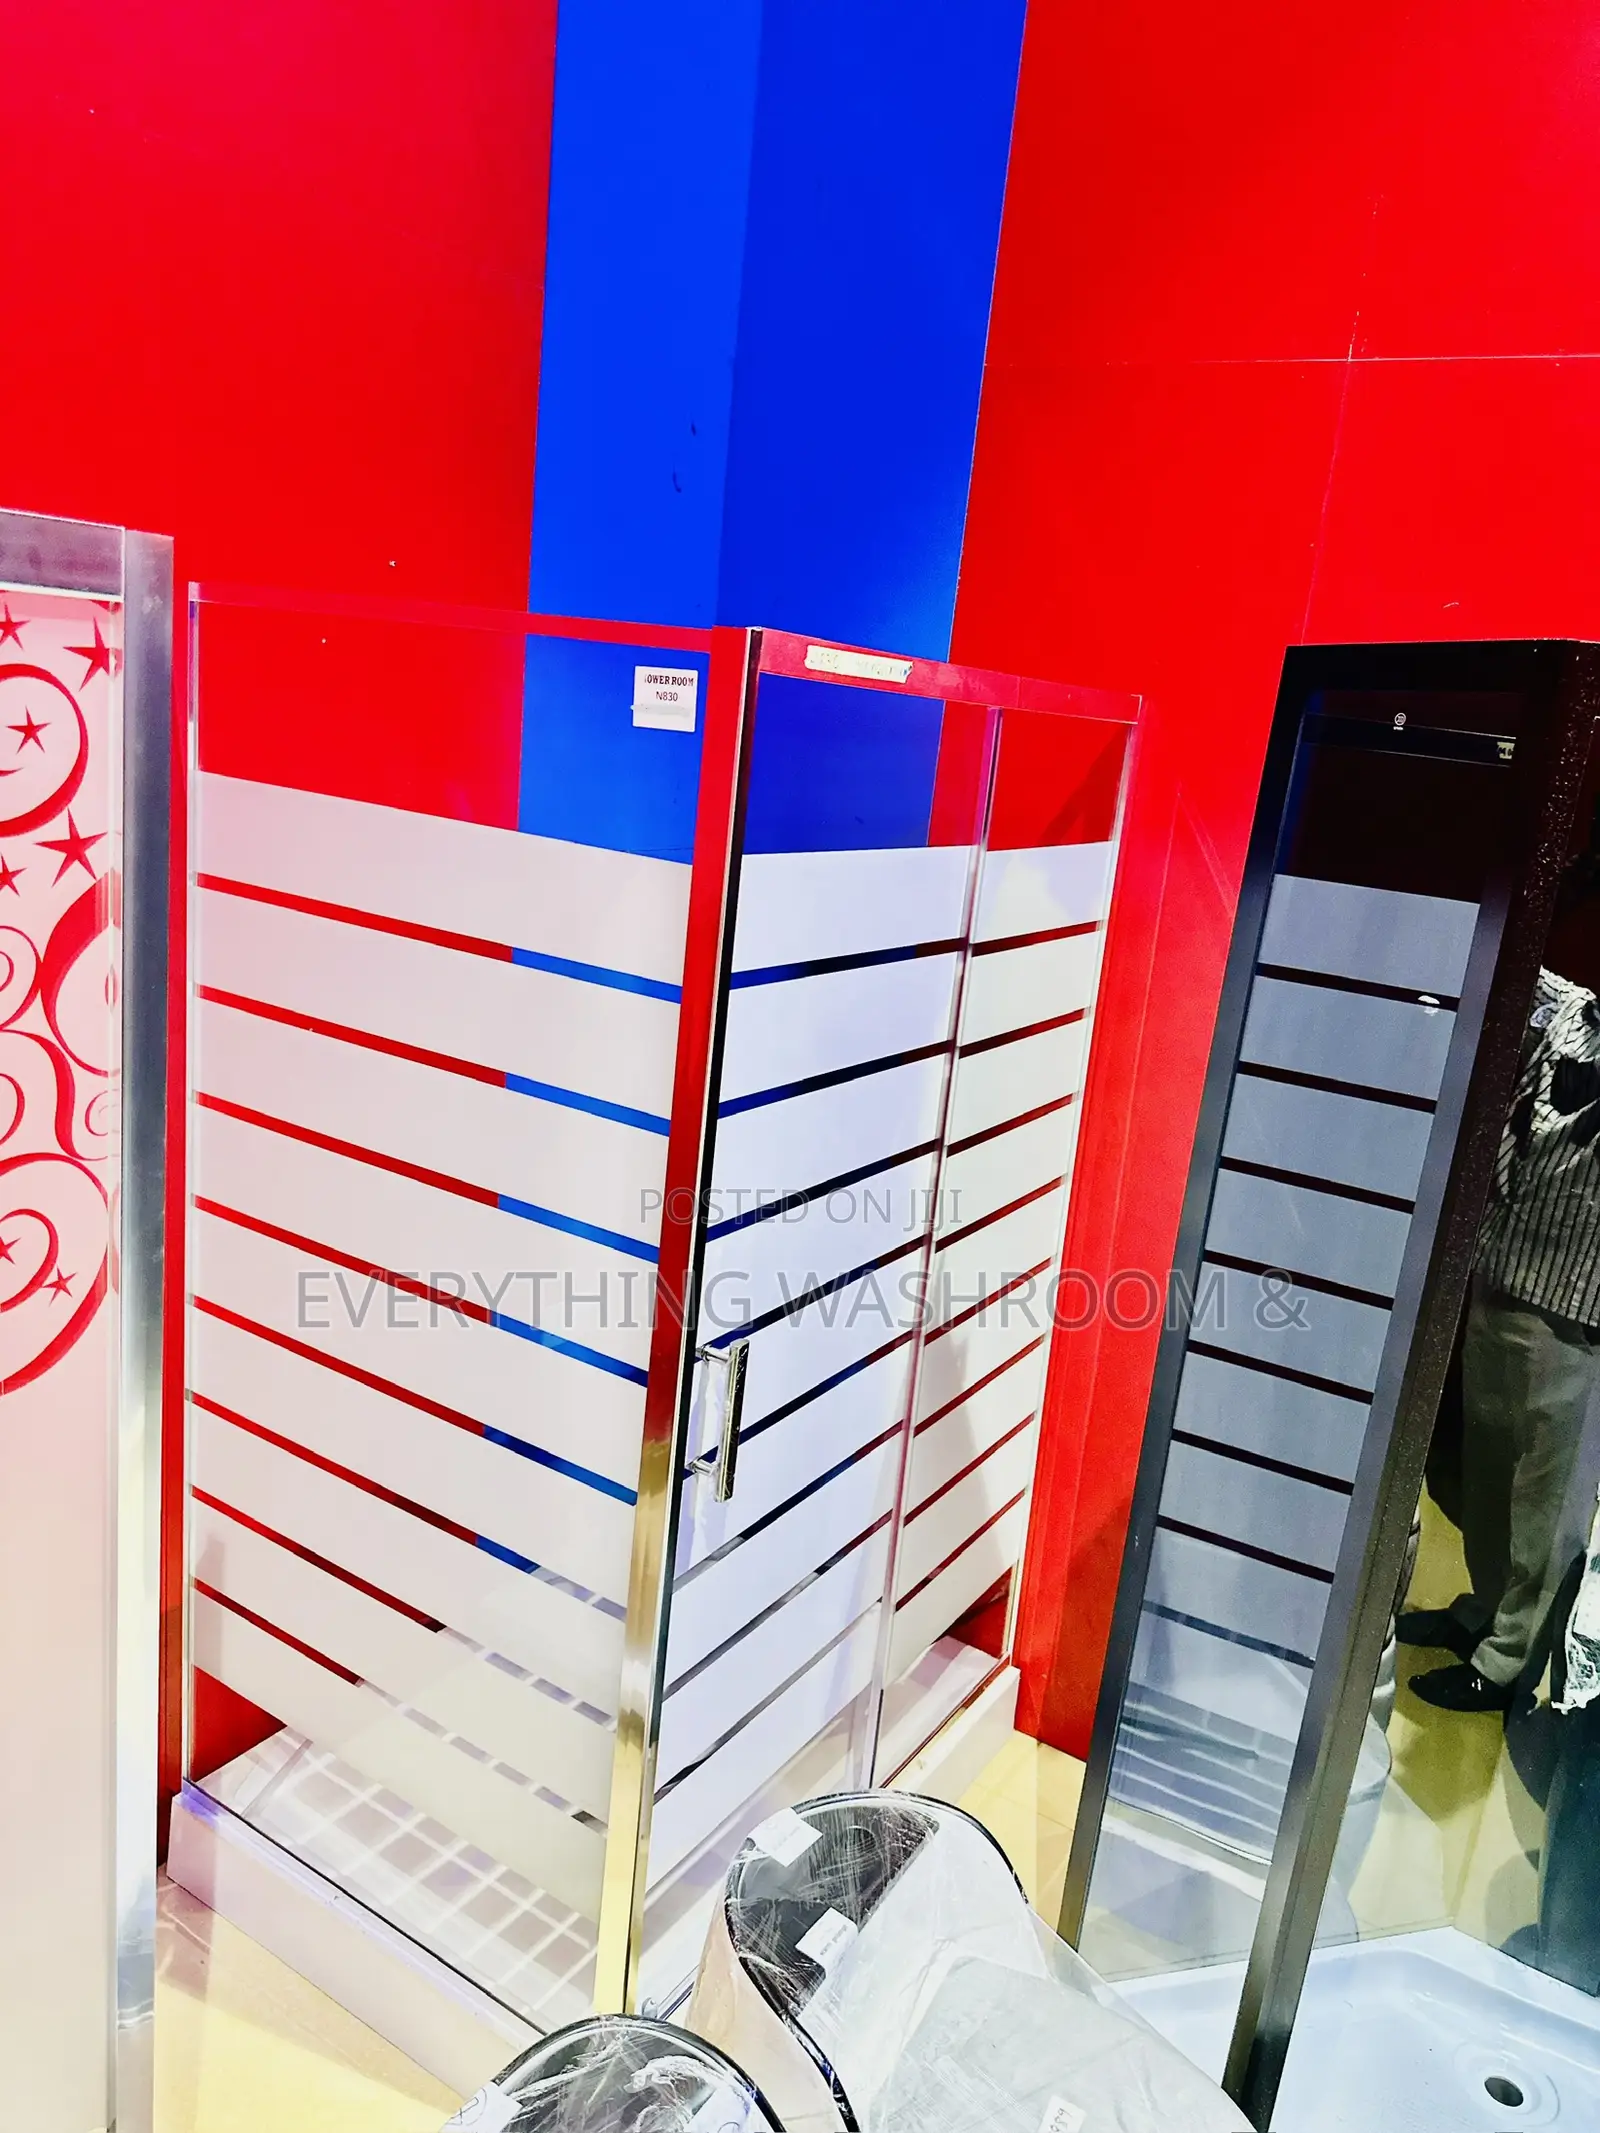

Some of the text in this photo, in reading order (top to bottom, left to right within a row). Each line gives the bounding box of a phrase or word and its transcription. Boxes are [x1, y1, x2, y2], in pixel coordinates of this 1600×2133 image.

[644, 673, 694, 687] OWER ROOM
[655, 691, 679, 702] N830
